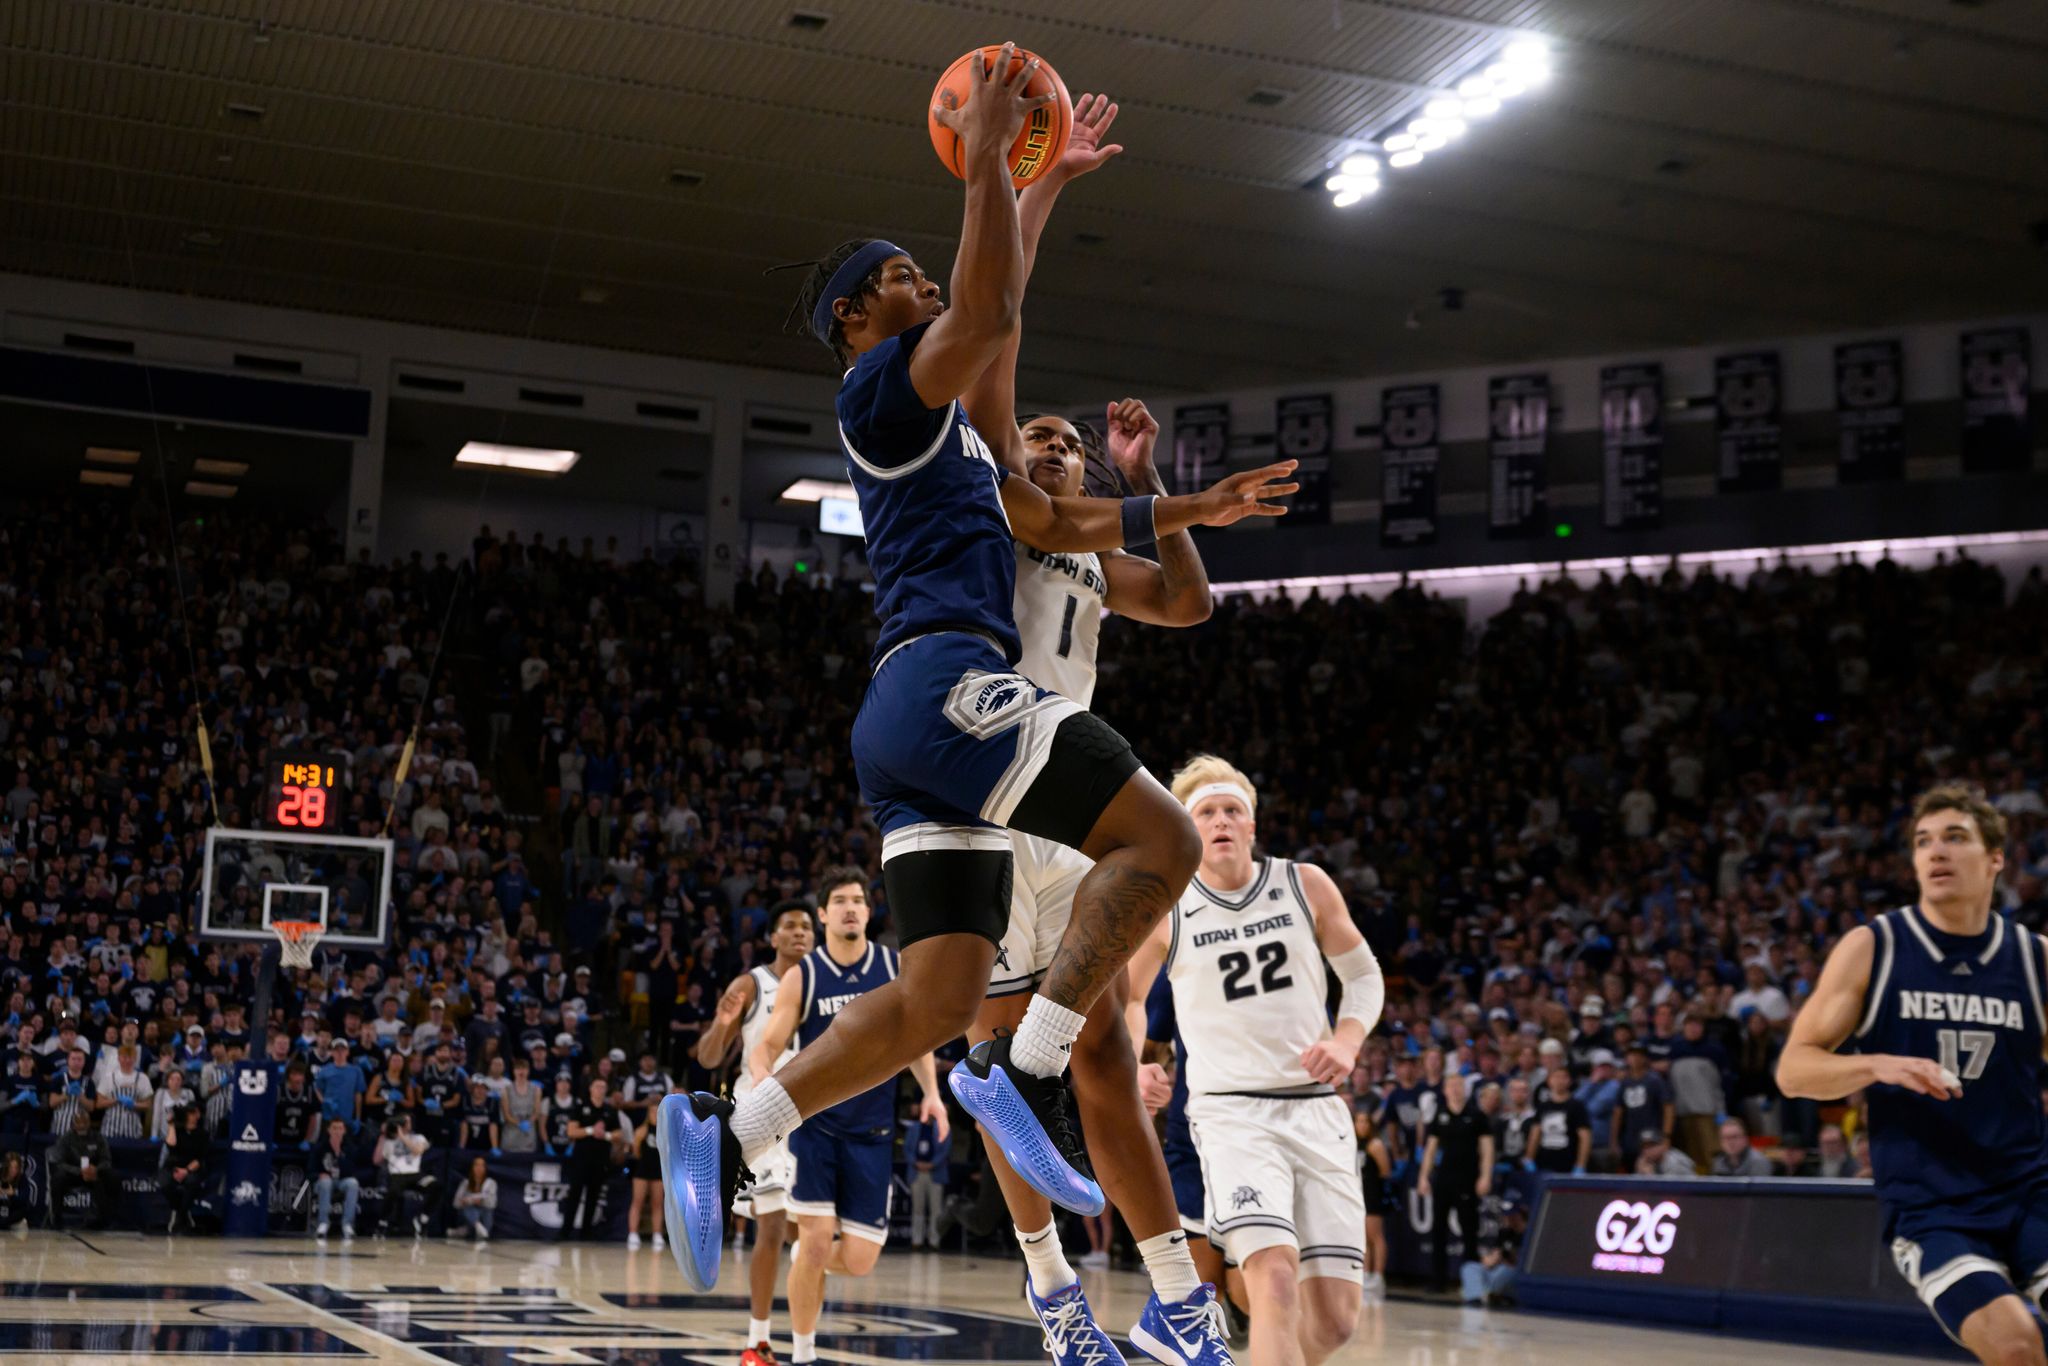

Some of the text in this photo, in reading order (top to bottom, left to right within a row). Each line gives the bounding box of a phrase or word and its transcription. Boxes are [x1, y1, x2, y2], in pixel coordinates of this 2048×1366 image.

[1011, 107, 1049, 178] ELITE
[1057, 594, 1078, 660] 1
[975, 679, 1014, 716] NEVADA
[283, 763, 334, 788] 14:31
[277, 785, 326, 827] 28
[1193, 913, 1294, 948] UTAH STATE
[1218, 940, 1294, 1003] 22
[1899, 990, 2025, 1031] NEVADA
[1936, 1028, 1996, 1080] 17
[1595, 1199, 1681, 1255] G2G
